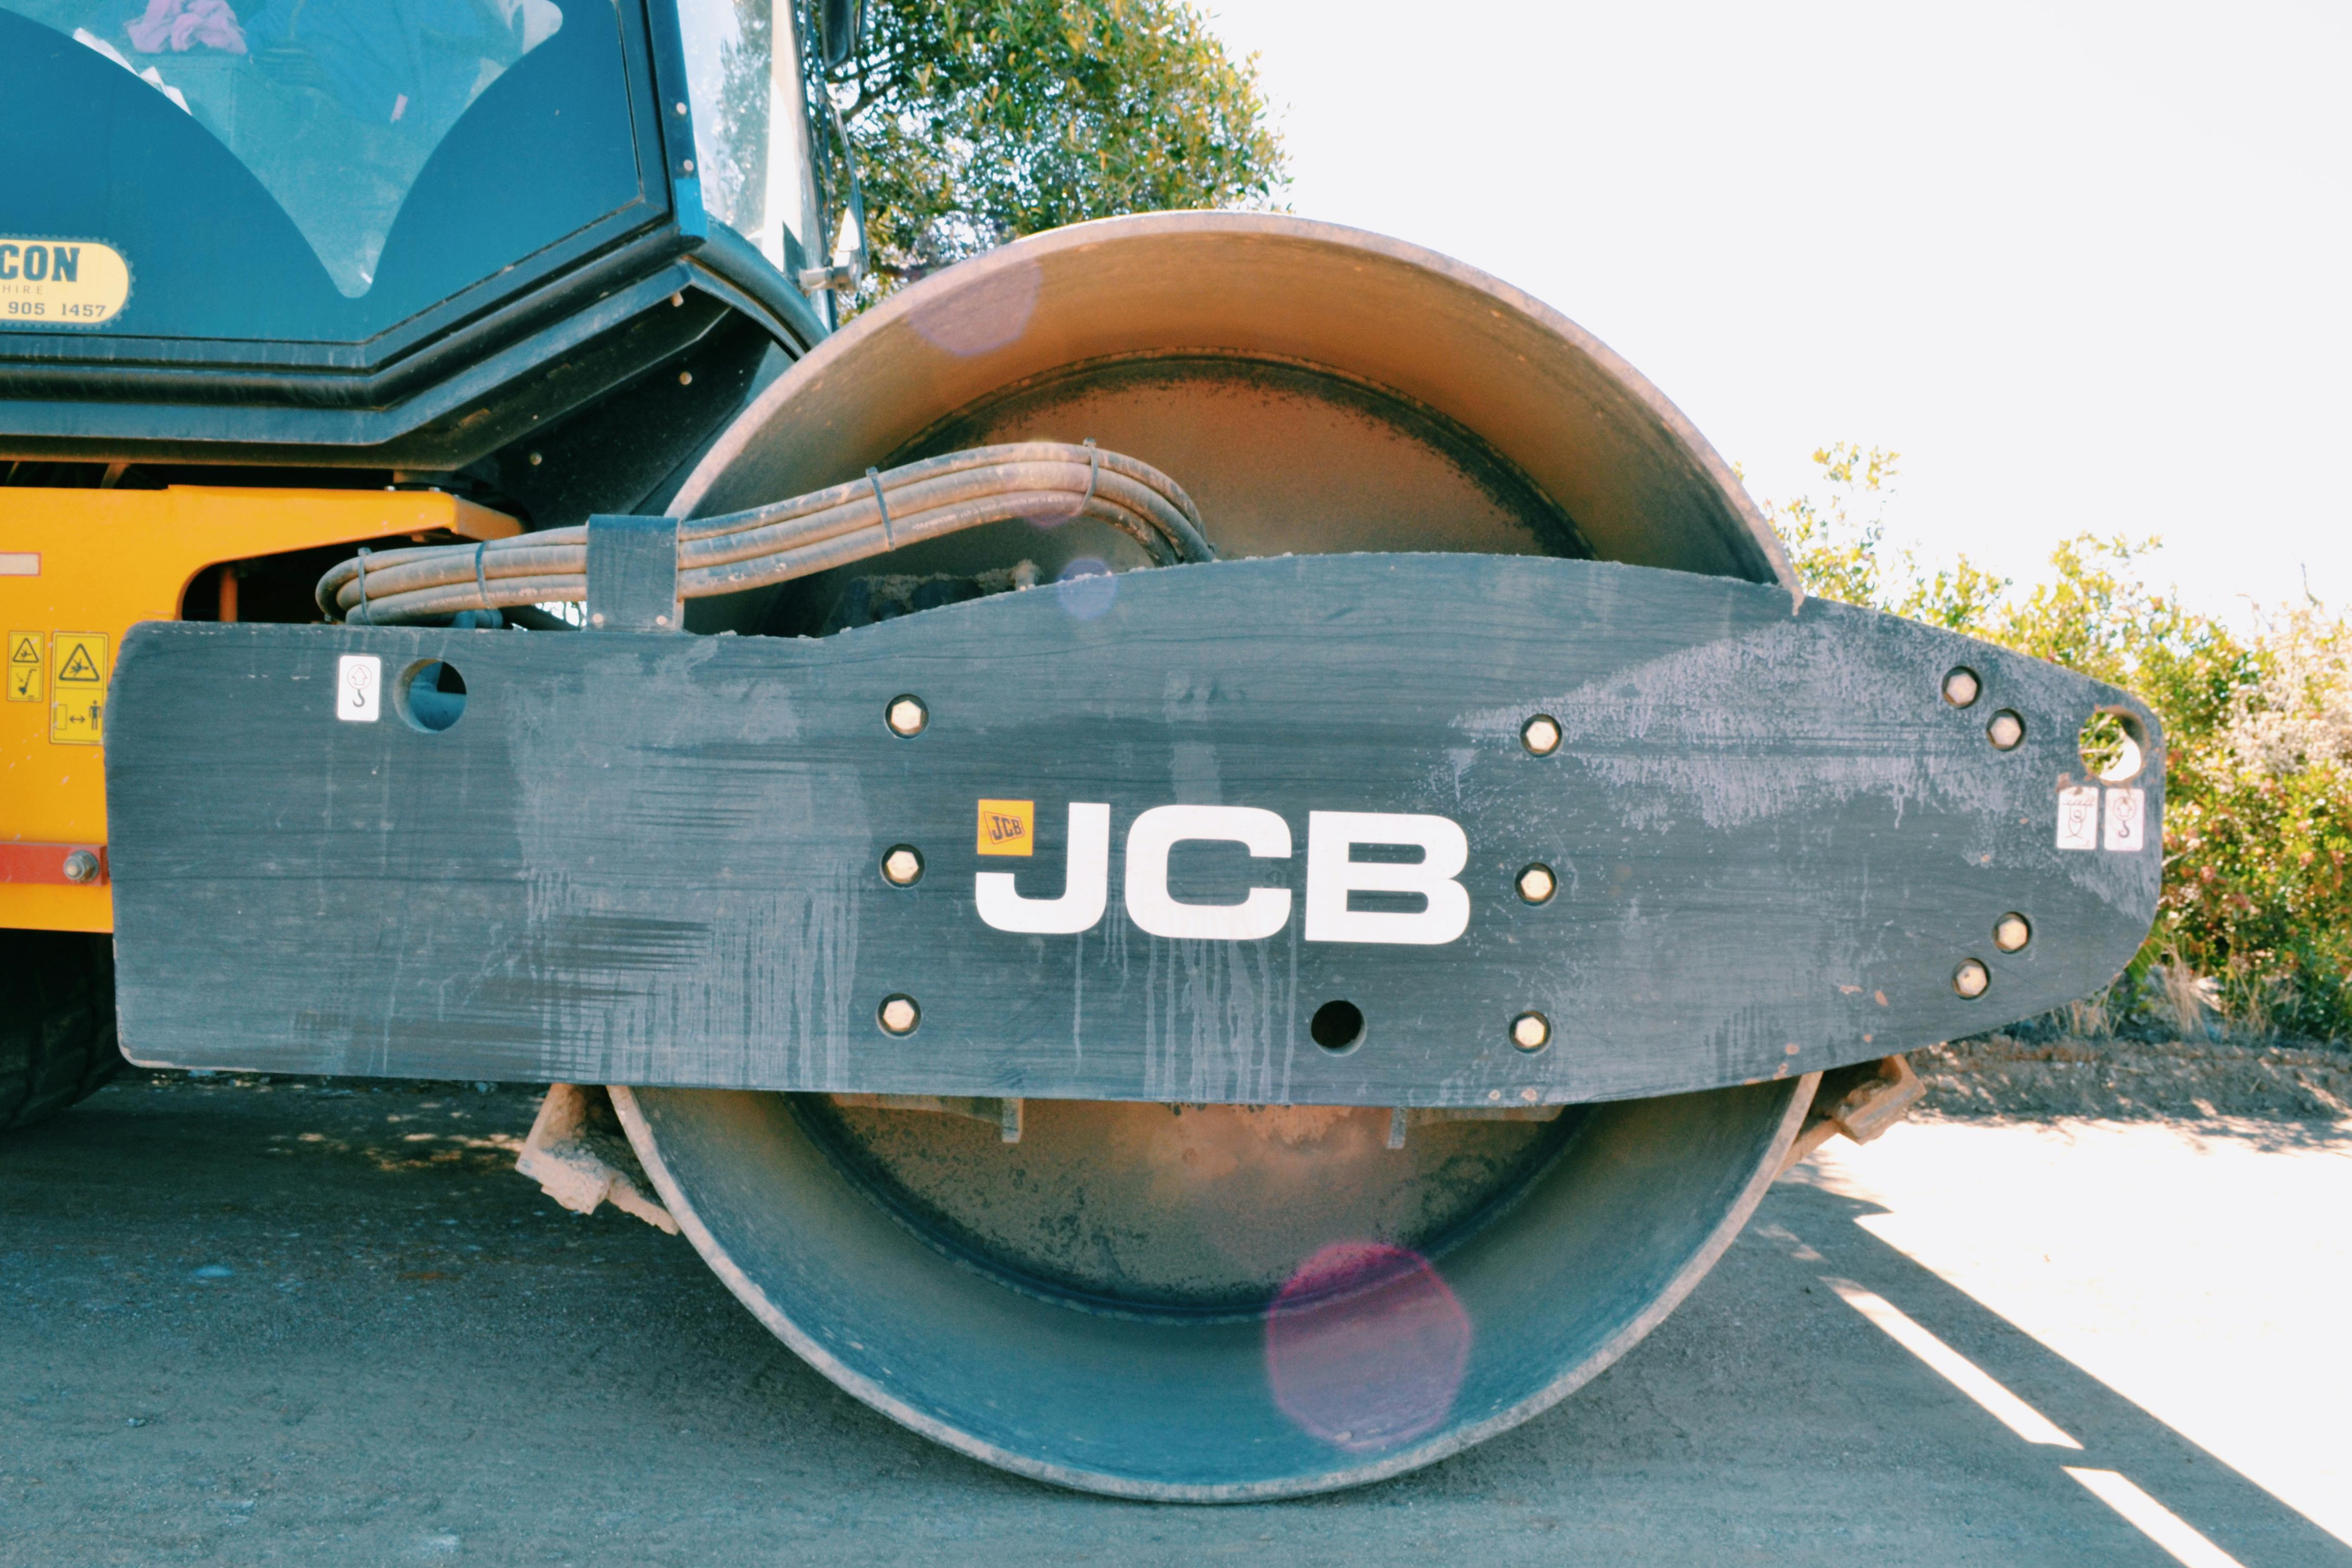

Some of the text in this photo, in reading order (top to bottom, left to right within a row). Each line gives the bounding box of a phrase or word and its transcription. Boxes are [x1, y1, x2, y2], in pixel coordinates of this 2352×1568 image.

[3, 284, 43, 295] HIRE
[8, 301, 106, 317] 905 1457
[992, 816, 1022, 840] JCB
[976, 802, 1470, 945] JCB
